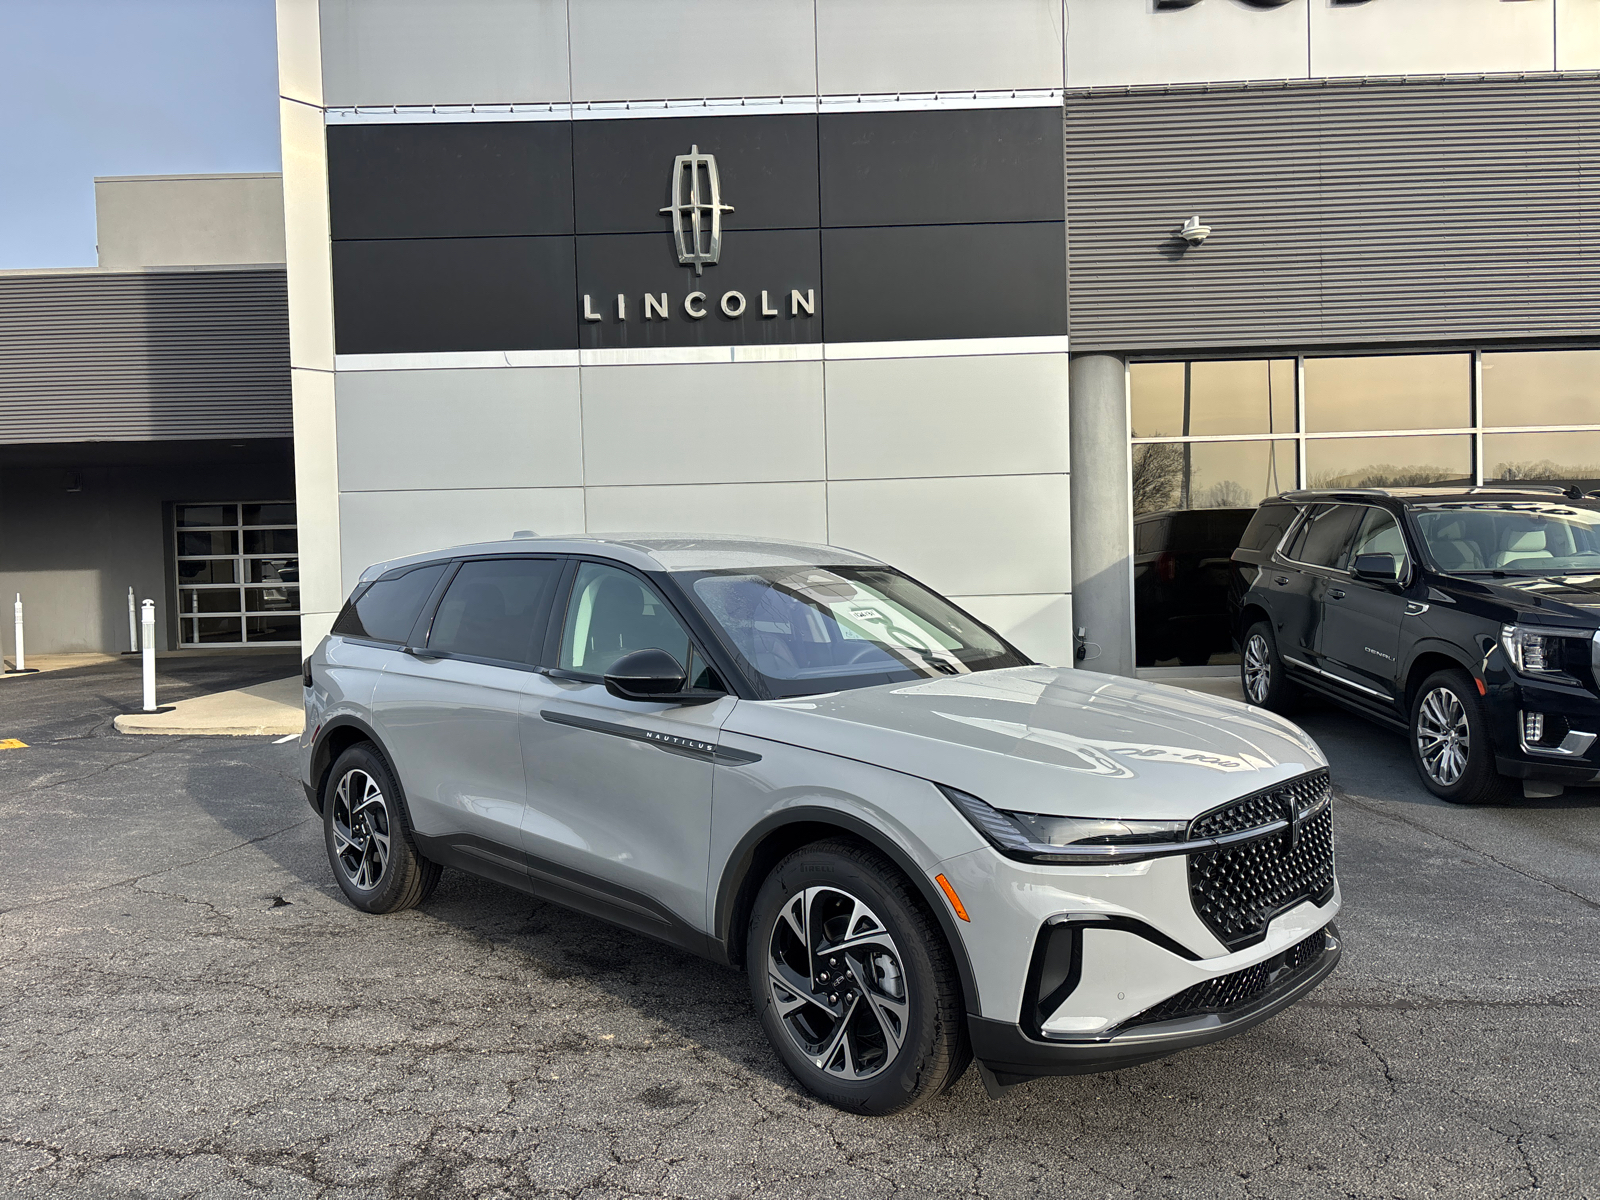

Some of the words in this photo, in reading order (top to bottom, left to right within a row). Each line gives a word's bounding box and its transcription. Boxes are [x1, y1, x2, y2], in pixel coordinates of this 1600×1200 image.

[583, 288, 815, 322] LINCOLN
[1364, 646, 1396, 662] DENALI
[646, 732, 713, 751] NAUTILUS
[800, 861, 835, 873] PIRELLI
